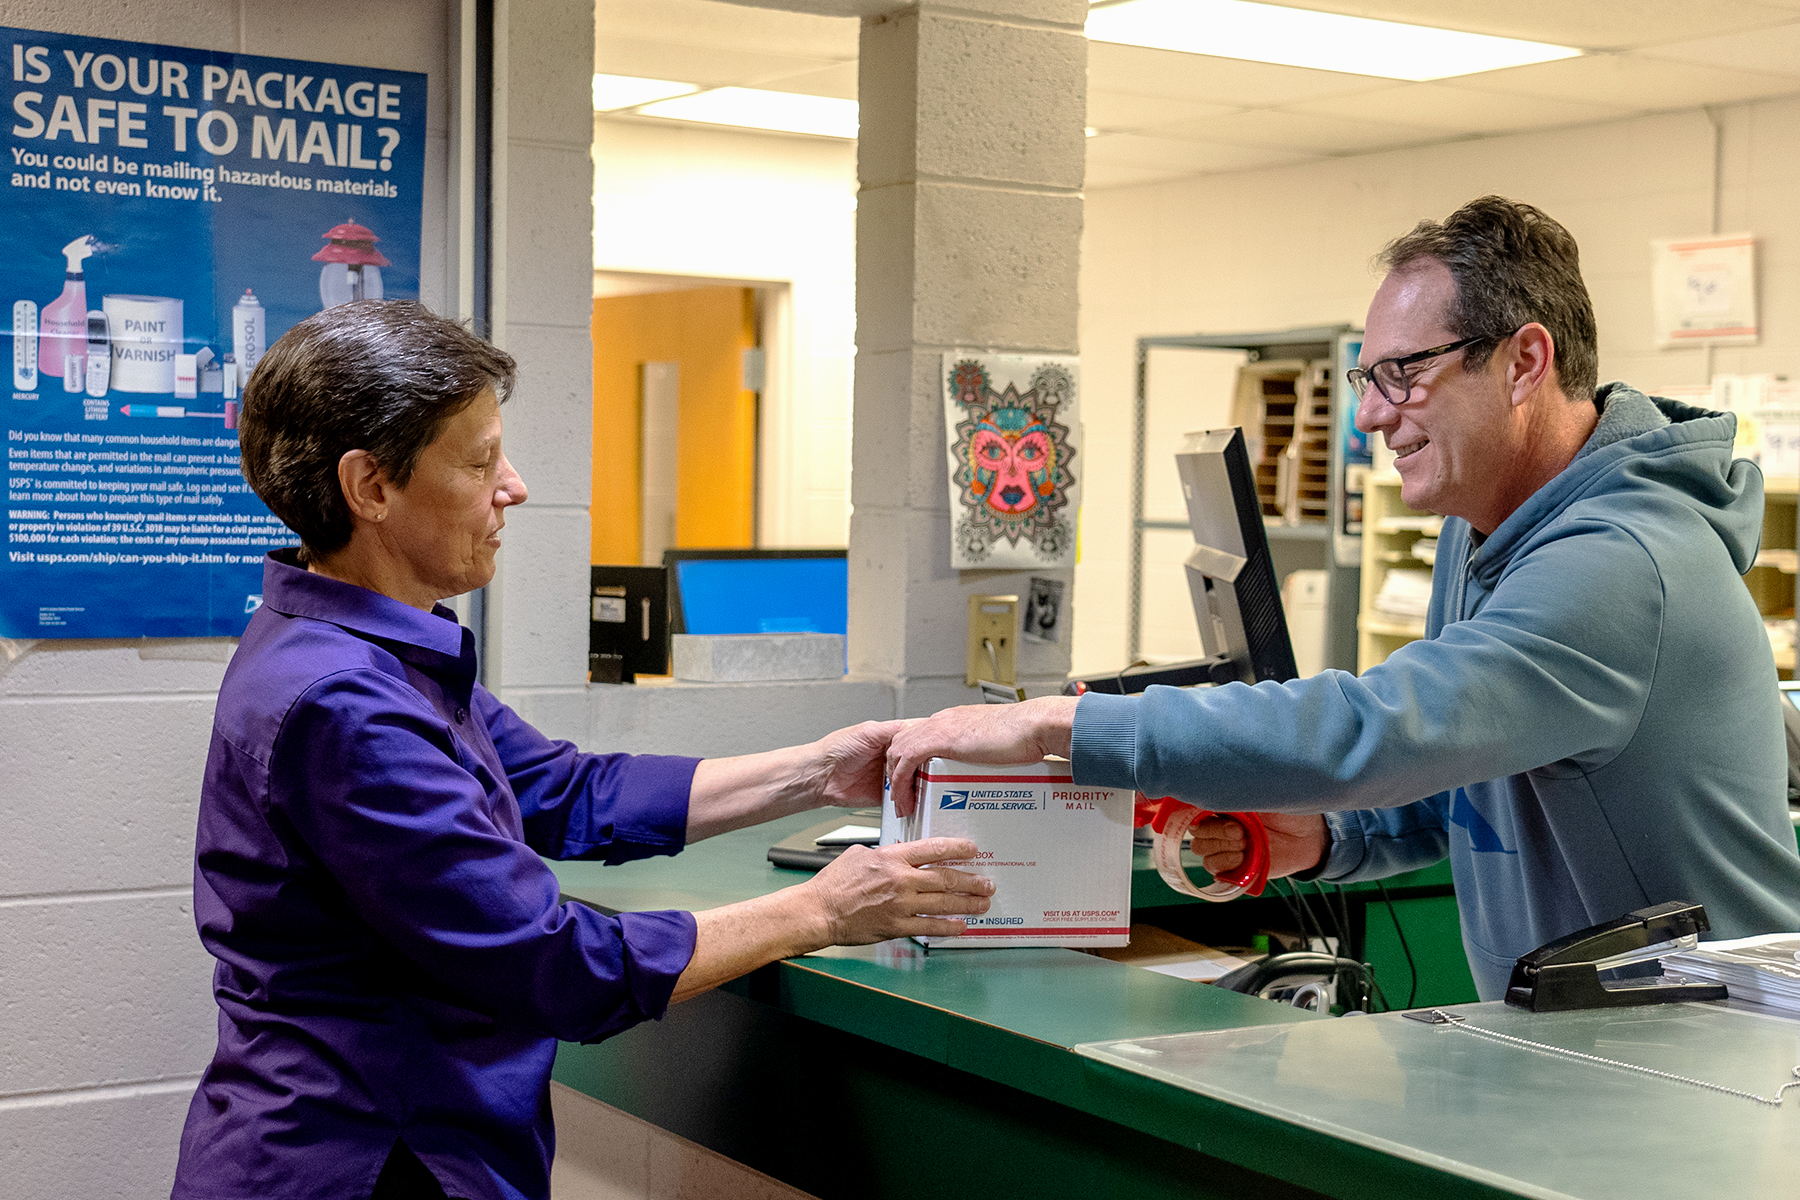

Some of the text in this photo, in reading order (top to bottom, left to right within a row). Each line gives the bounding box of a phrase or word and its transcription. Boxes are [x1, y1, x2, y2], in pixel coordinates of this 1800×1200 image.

[13, 44, 401, 120] IS YOUR PACKAGE
[12, 92, 401, 171] SAFE TO MAIL?
[11, 147, 398, 198] You could be mailing hazardous materials
[11, 170, 222, 202] and not even know it.
[125, 319, 166, 332] PAINT
[140, 336, 152, 344] OR
[245, 317, 256, 375] EROSOL
[115, 347, 176, 362] VARNISH
[12, 392, 40, 400] MERCURY
[9, 430, 22, 441] Did
[24, 433, 38, 443] you
[40, 432, 62, 441] know
[64, 432, 80, 442] that
[82, 434, 104, 445] many
[105, 435, 140, 444] common
[141, 434, 180, 445] household
[181, 436, 201, 446] items
[202, 438, 214, 446] are
[9, 448, 28, 458] Even
[30, 449, 53, 459] items
[55, 449, 72, 460] that
[88, 451, 128, 462] permitted
[130, 452, 138, 461] in
[140, 452, 153, 462] the
[154, 452, 172, 462] mail
[173, 454, 186, 463] can
[188, 454, 215, 464] present
[9, 462, 60, 472] temperature
[62, 461, 96, 474] changes,
[98, 463, 113, 472] and
[115, 464, 152, 474] variations
[154, 464, 161, 473] in
[163, 465, 208, 476] atmospheric
[35, 479, 42, 488] is
[43, 480, 87, 490] committed
[89, 481, 97, 490] to
[98, 480, 130, 492] keeping
[131, 483, 148, 492] your
[150, 482, 166, 492] mail
[168, 482, 185, 492] safe.
[186, 482, 200, 494] Log
[212, 482, 226, 492] and
[228, 485, 240, 493] see
[242, 484, 248, 493] if
[9, 490, 30, 500] learn
[55, 492, 78, 501] about
[80, 492, 97, 502] how
[99, 493, 107, 502] to
[109, 494, 139, 504] prepare
[140, 494, 154, 503] this
[156, 495, 173, 505] type
[174, 494, 182, 503] of
[184, 494, 200, 504] mail
[202, 494, 224, 506] safely.
[9, 510, 50, 520] WARNING:
[54, 510, 84, 520] Persons
[86, 511, 103, 520] who
[105, 512, 146, 523] knowingly
[147, 512, 164, 522] mail
[166, 512, 187, 522] items
[197, 513, 232, 522] materials
[234, 514, 250, 522] that
[20, 524, 55, 534] property
[56, 522, 64, 532] in
[66, 522, 101, 532] violation
[102, 523, 110, 532] of
[112, 524, 121, 532] 39
[122, 524, 144, 532] U.S.C.
[164, 526, 180, 535] may
[181, 524, 191, 533] be
[192, 524, 212, 533] liable
[213, 524, 224, 534] for
[225, 526, 230, 534] a
[232, 526, 247, 534] civil
[248, 526, 277, 536] penalty
[278, 526, 287, 534] of
[9, 533, 46, 544] $100,000
[47, 534, 60, 542] for
[60, 534, 80, 544] each
[81, 534, 118, 544] violation;
[120, 534, 134, 544] the
[135, 535, 154, 544] costs
[155, 535, 164, 544] of
[164, 537, 179, 546] any
[180, 535, 209, 546] cleanup
[210, 536, 250, 545] associated
[250, 536, 268, 546] with
[270, 537, 287, 546] each
[9, 552, 34, 562] Visit
[36, 552, 223, 565] usps.com/ship/can-you-ship-it.htm
[224, 553, 240, 563] for
